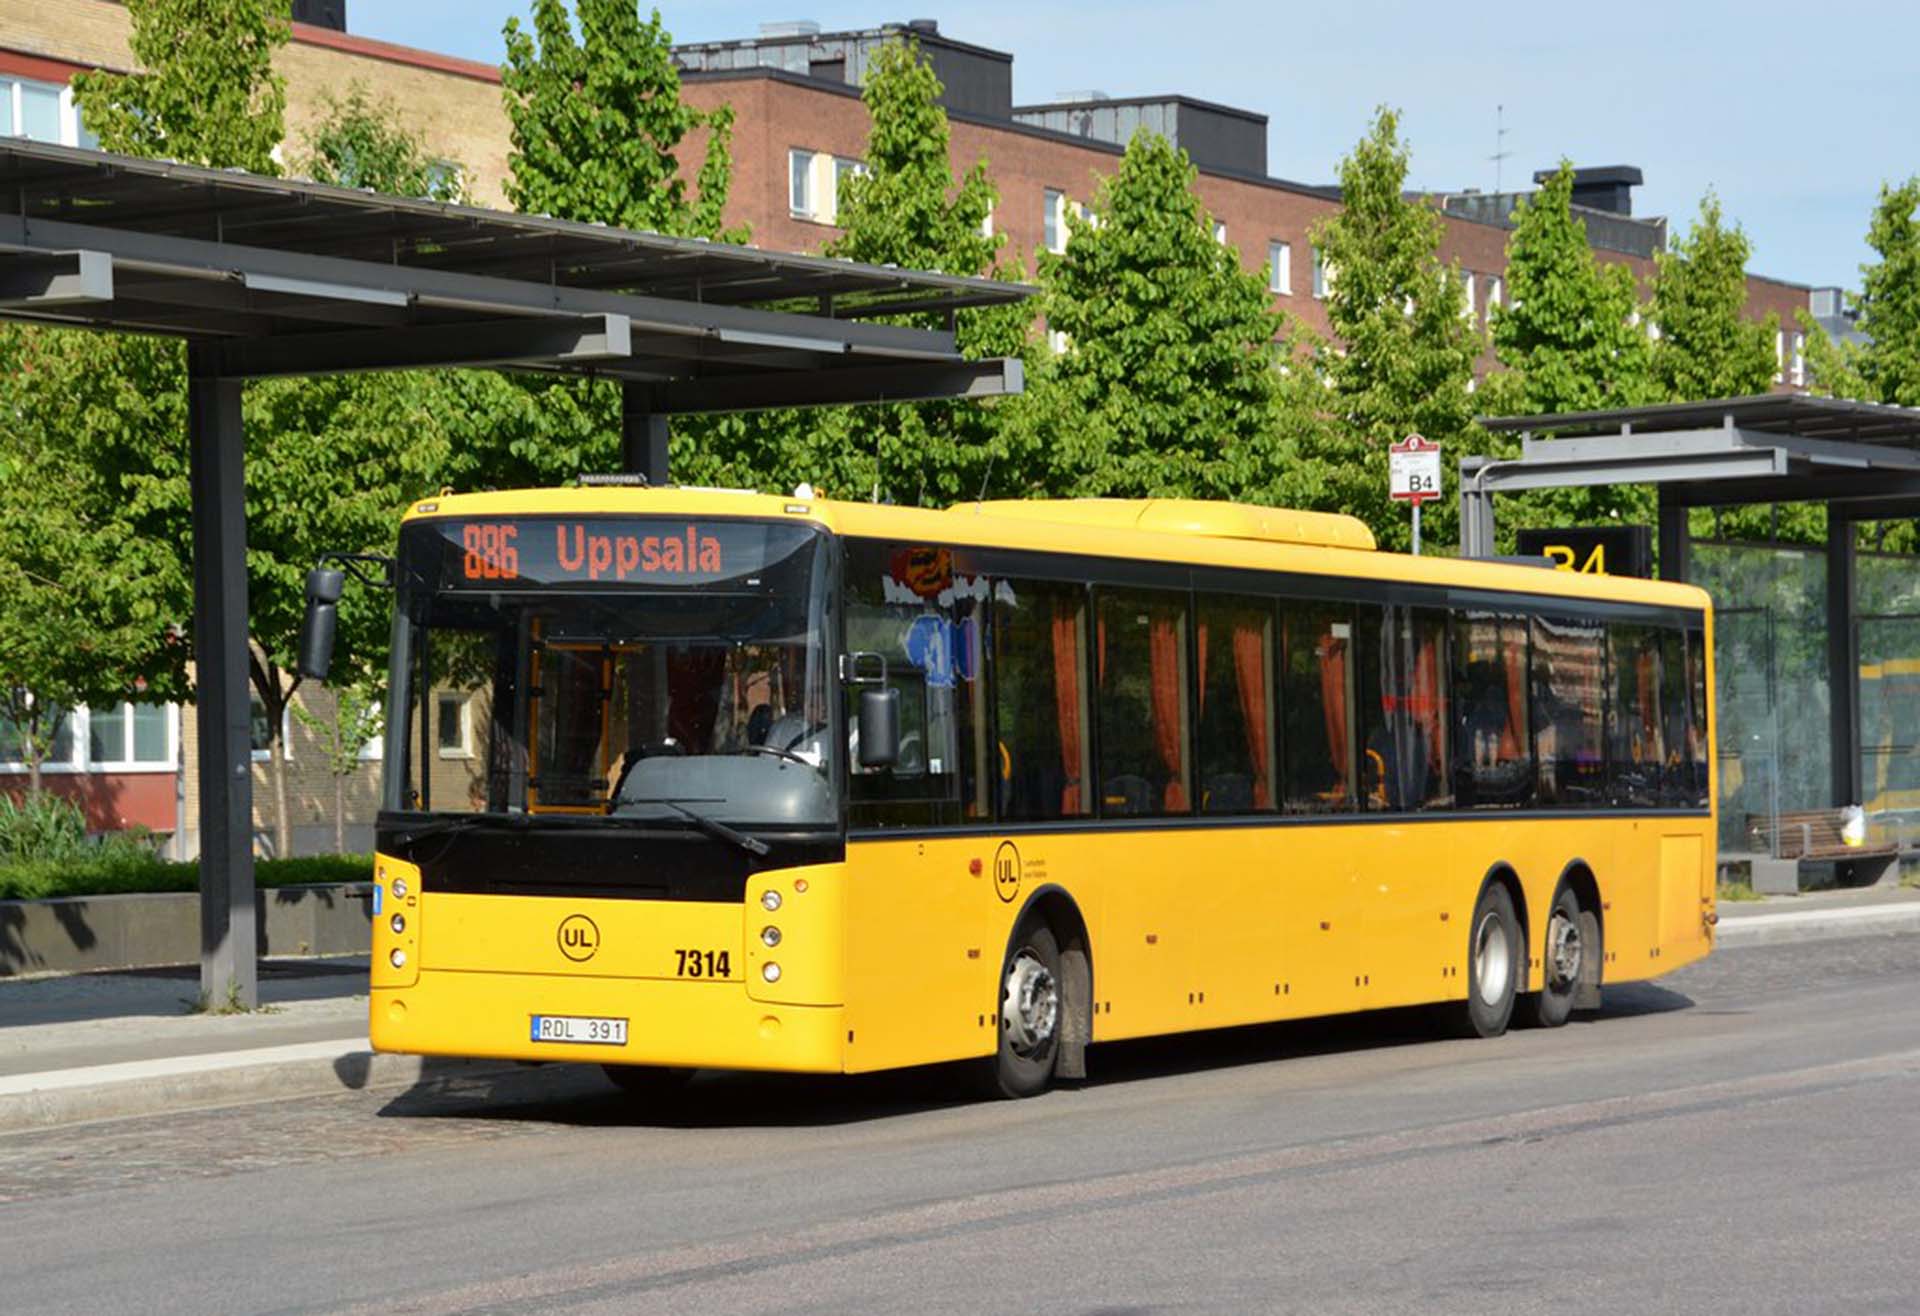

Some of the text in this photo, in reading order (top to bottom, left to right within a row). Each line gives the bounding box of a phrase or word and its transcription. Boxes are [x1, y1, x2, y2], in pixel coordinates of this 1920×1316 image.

[1409, 474, 1433, 492] B4
[463, 523, 722, 581] 886 Uppsala
[998, 859, 1017, 884] UL
[564, 928, 593, 948] UL
[674, 949, 731, 978] 7314
[541, 1018, 622, 1041] RDL 391
